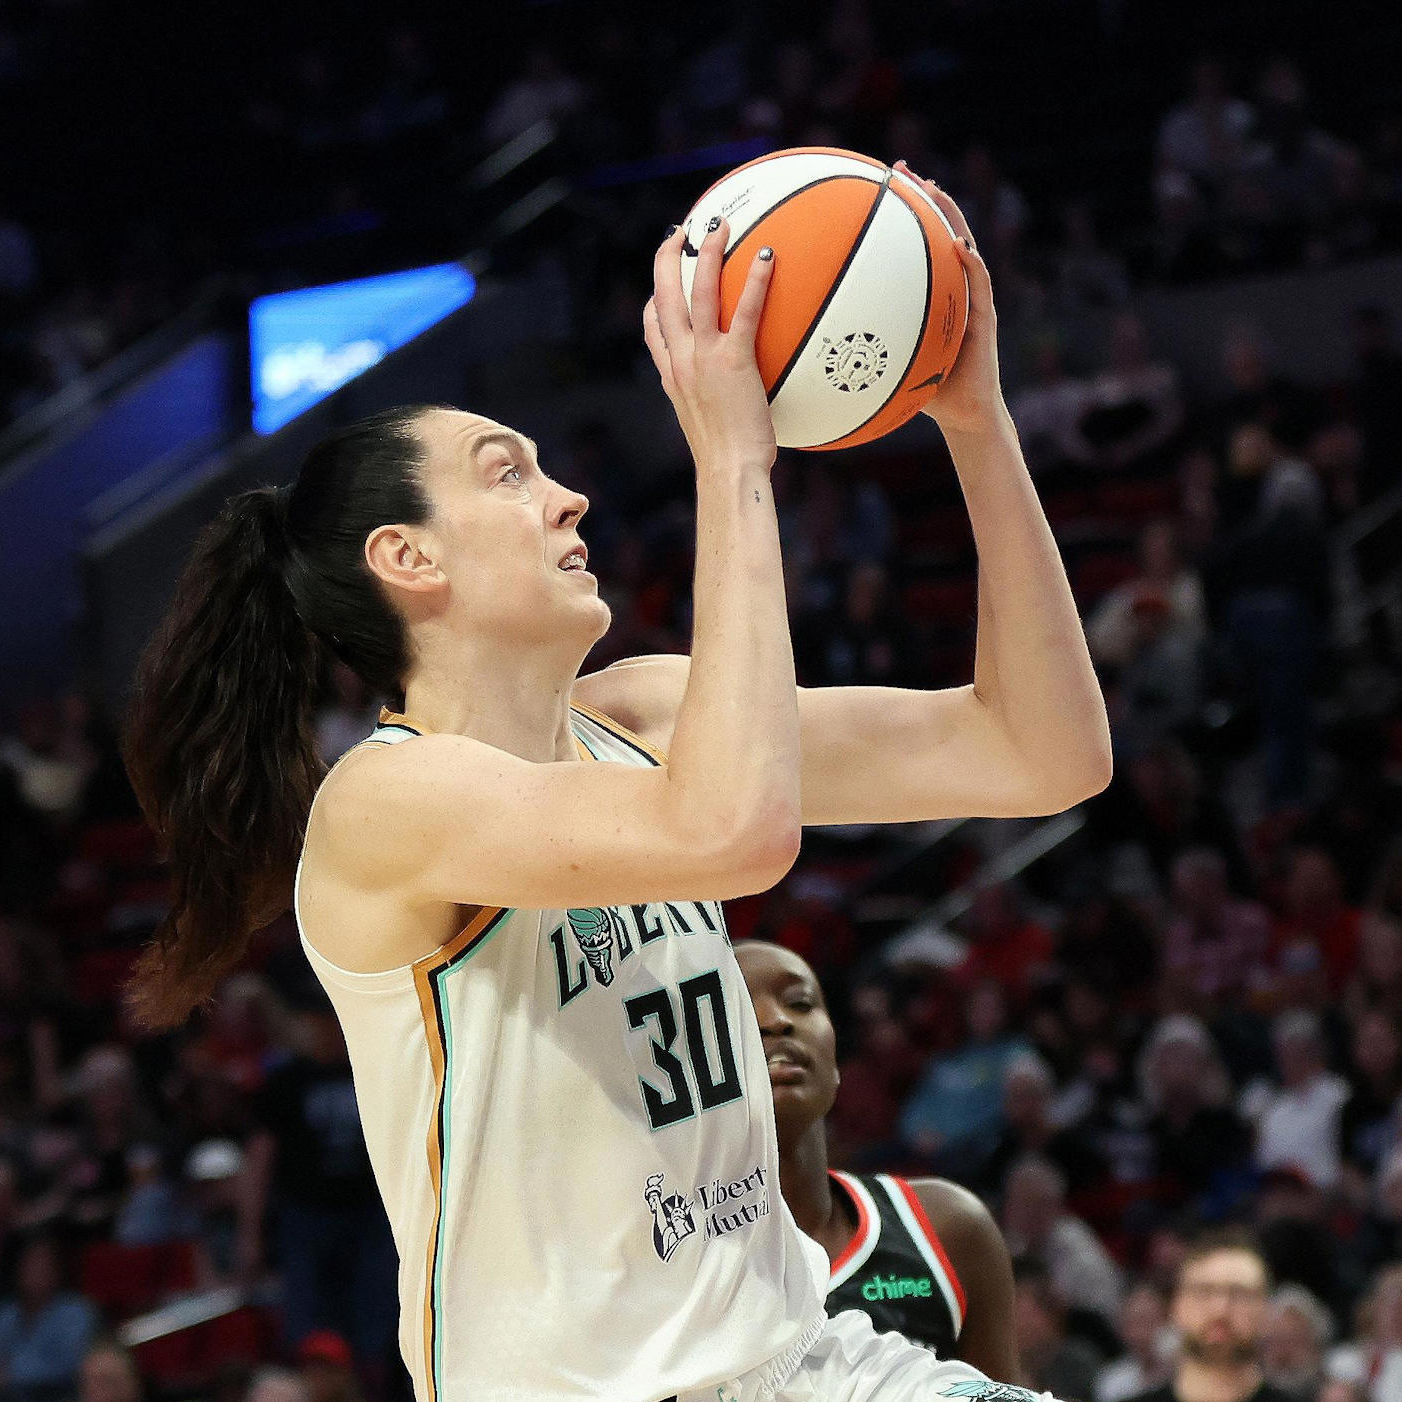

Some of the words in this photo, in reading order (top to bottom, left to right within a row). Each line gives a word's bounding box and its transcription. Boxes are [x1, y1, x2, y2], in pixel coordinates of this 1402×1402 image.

[623, 968, 744, 1132] 30
[697, 1165, 767, 1212] Libert
[862, 1273, 933, 1301] chime
